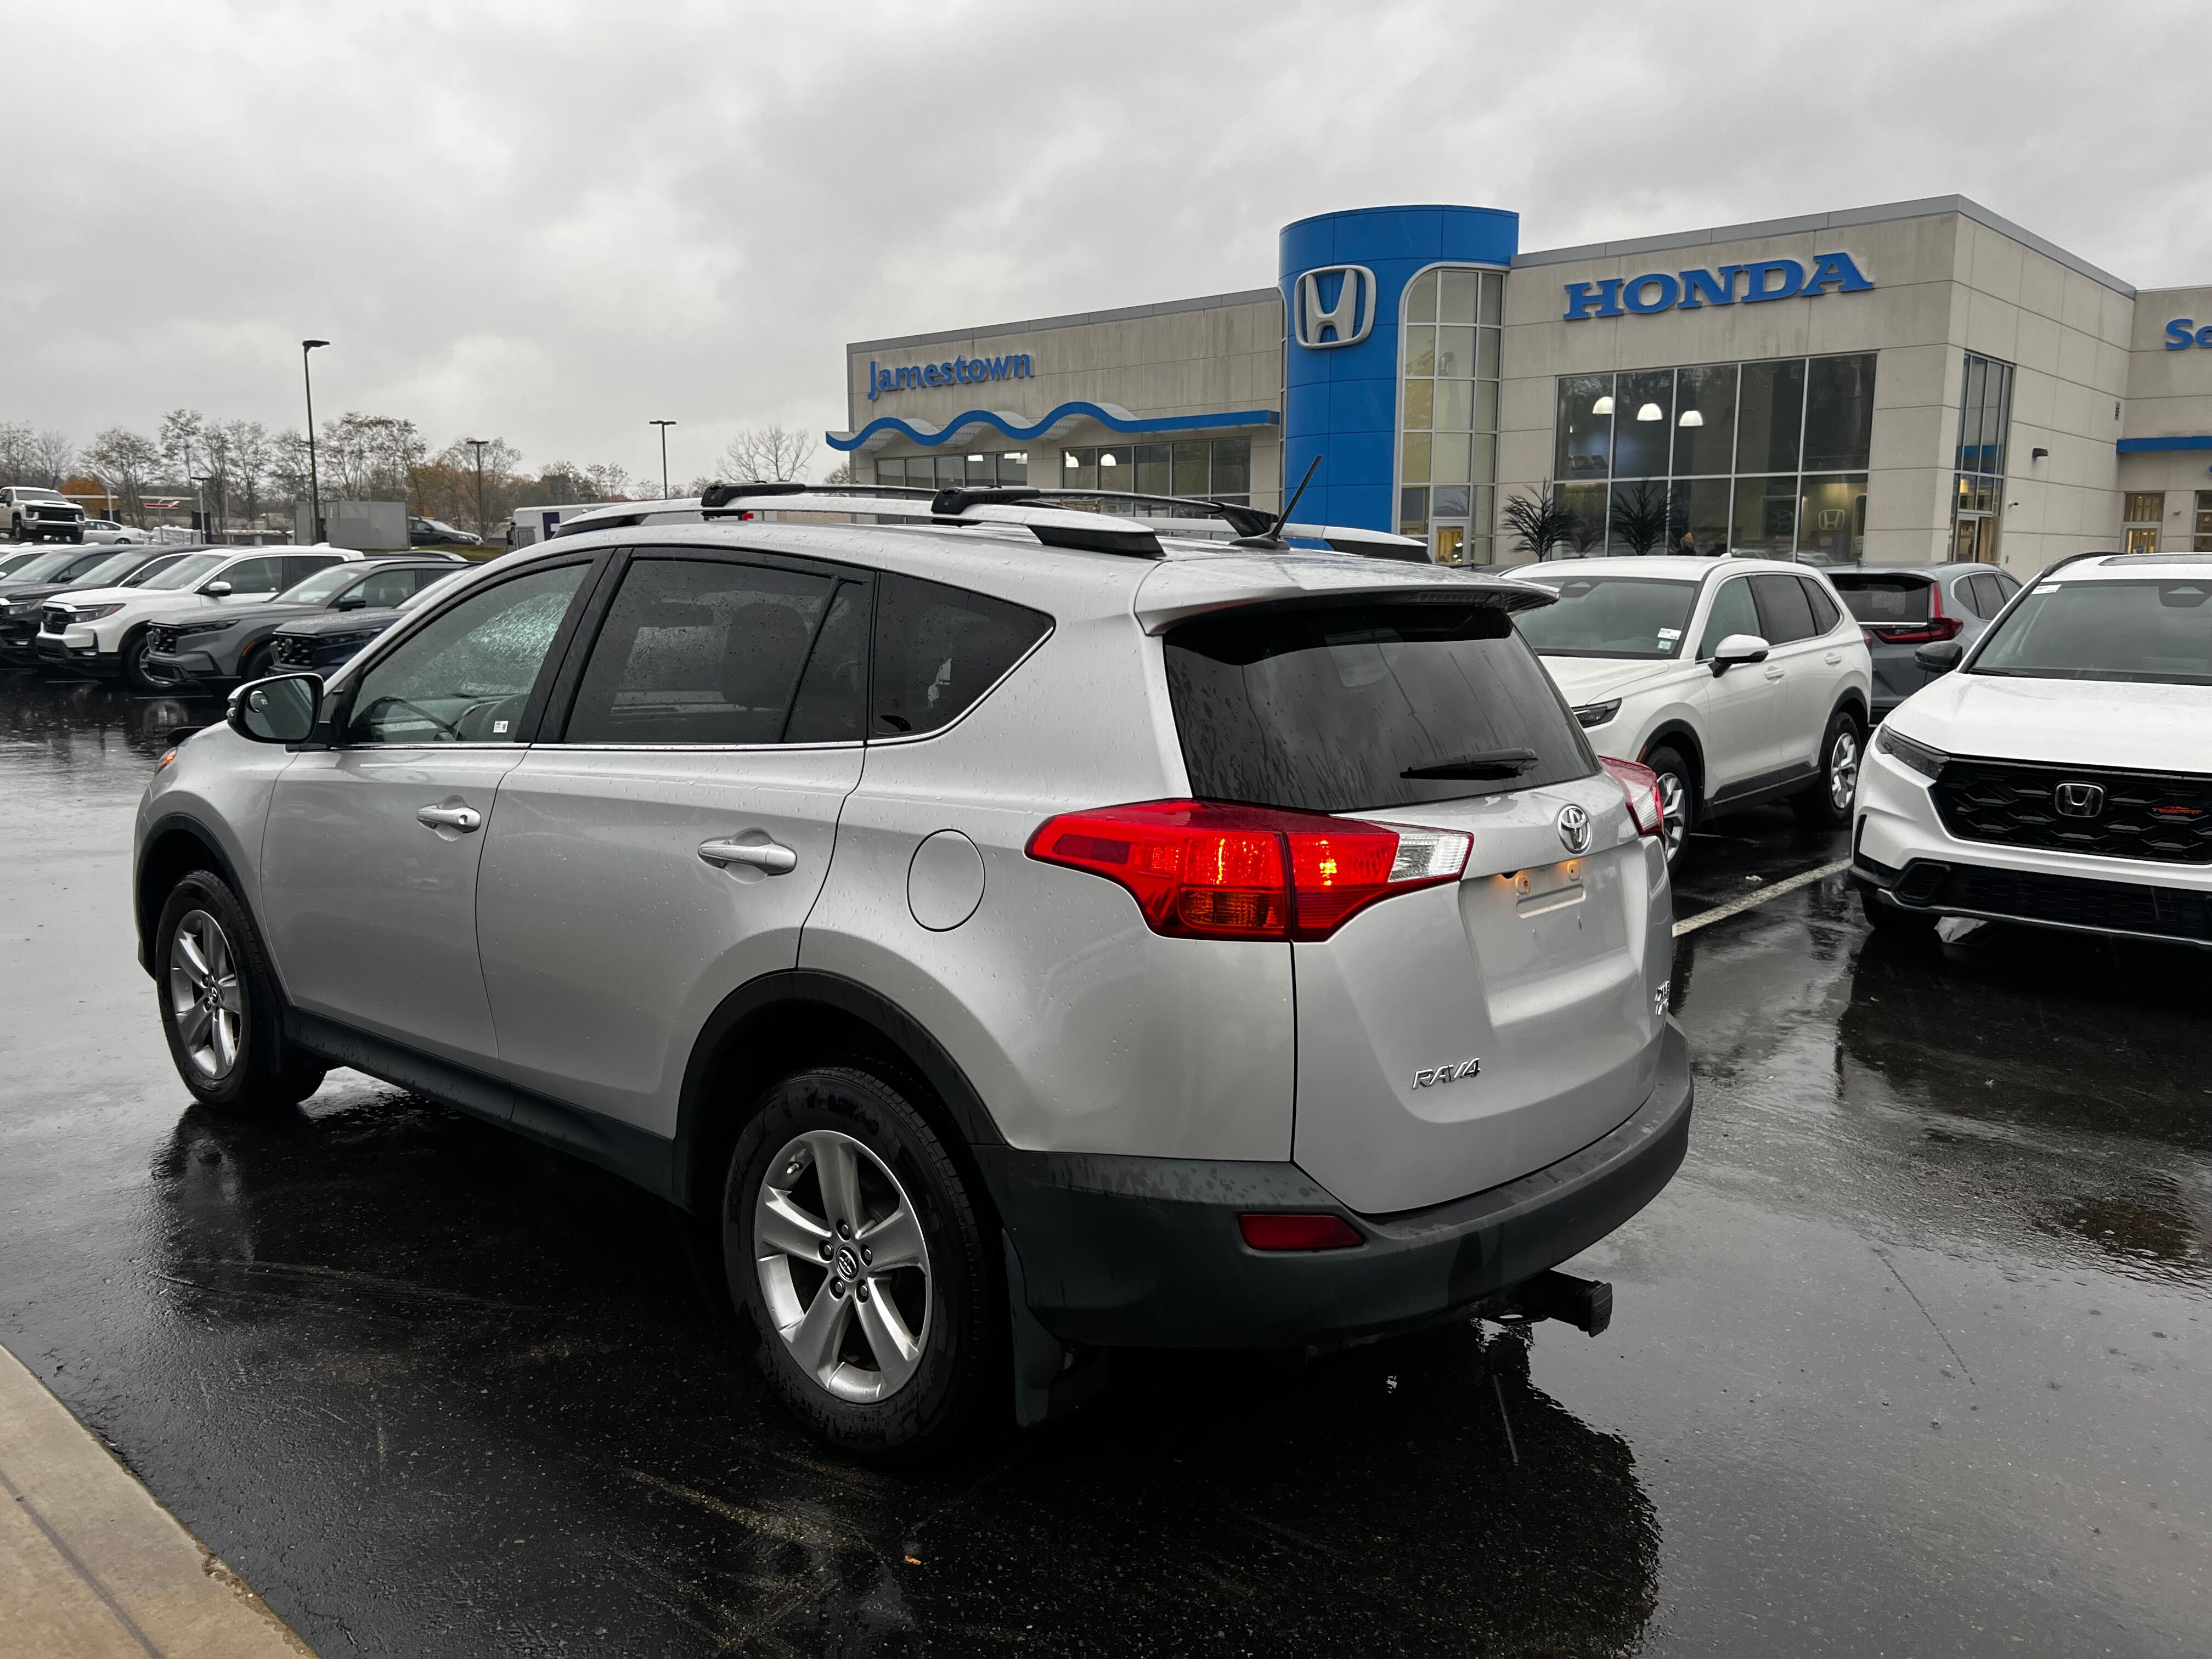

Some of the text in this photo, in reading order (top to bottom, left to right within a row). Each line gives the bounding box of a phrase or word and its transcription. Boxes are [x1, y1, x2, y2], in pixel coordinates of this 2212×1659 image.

[1563, 252, 1873, 320] HONDA
[868, 354, 1031, 400] Jamestown
[1412, 1057, 1481, 1090] RAV4
